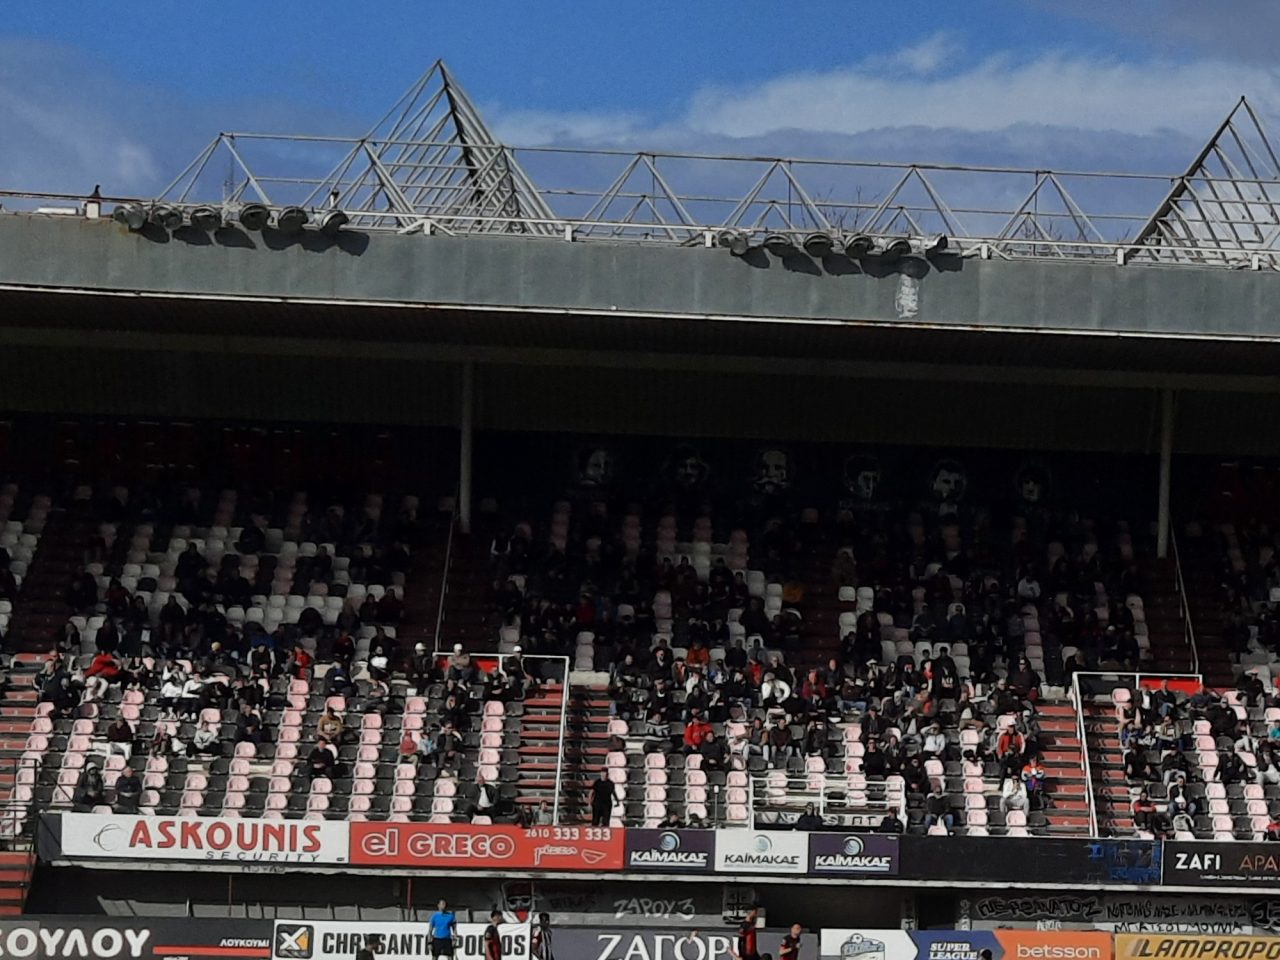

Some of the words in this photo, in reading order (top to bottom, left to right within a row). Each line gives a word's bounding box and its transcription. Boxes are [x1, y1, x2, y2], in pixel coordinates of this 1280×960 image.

[129, 819, 321, 852] ASKOUNIS
[525, 828, 550, 838] 2610
[553, 827, 580, 841] 333
[584, 828, 611, 842] 333
[361, 828, 399, 857] el
[407, 832, 516, 859] GRECO
[205, 850, 321, 863] SECURITY
[1175, 853, 1221, 871] ZAFI
[0, 927, 151, 958] ΟΥΛΟΥ
[930, 942, 971, 952] SUPER
[928, 951, 978, 960] LEAGUE
[1016, 943, 1100, 960] betsson
